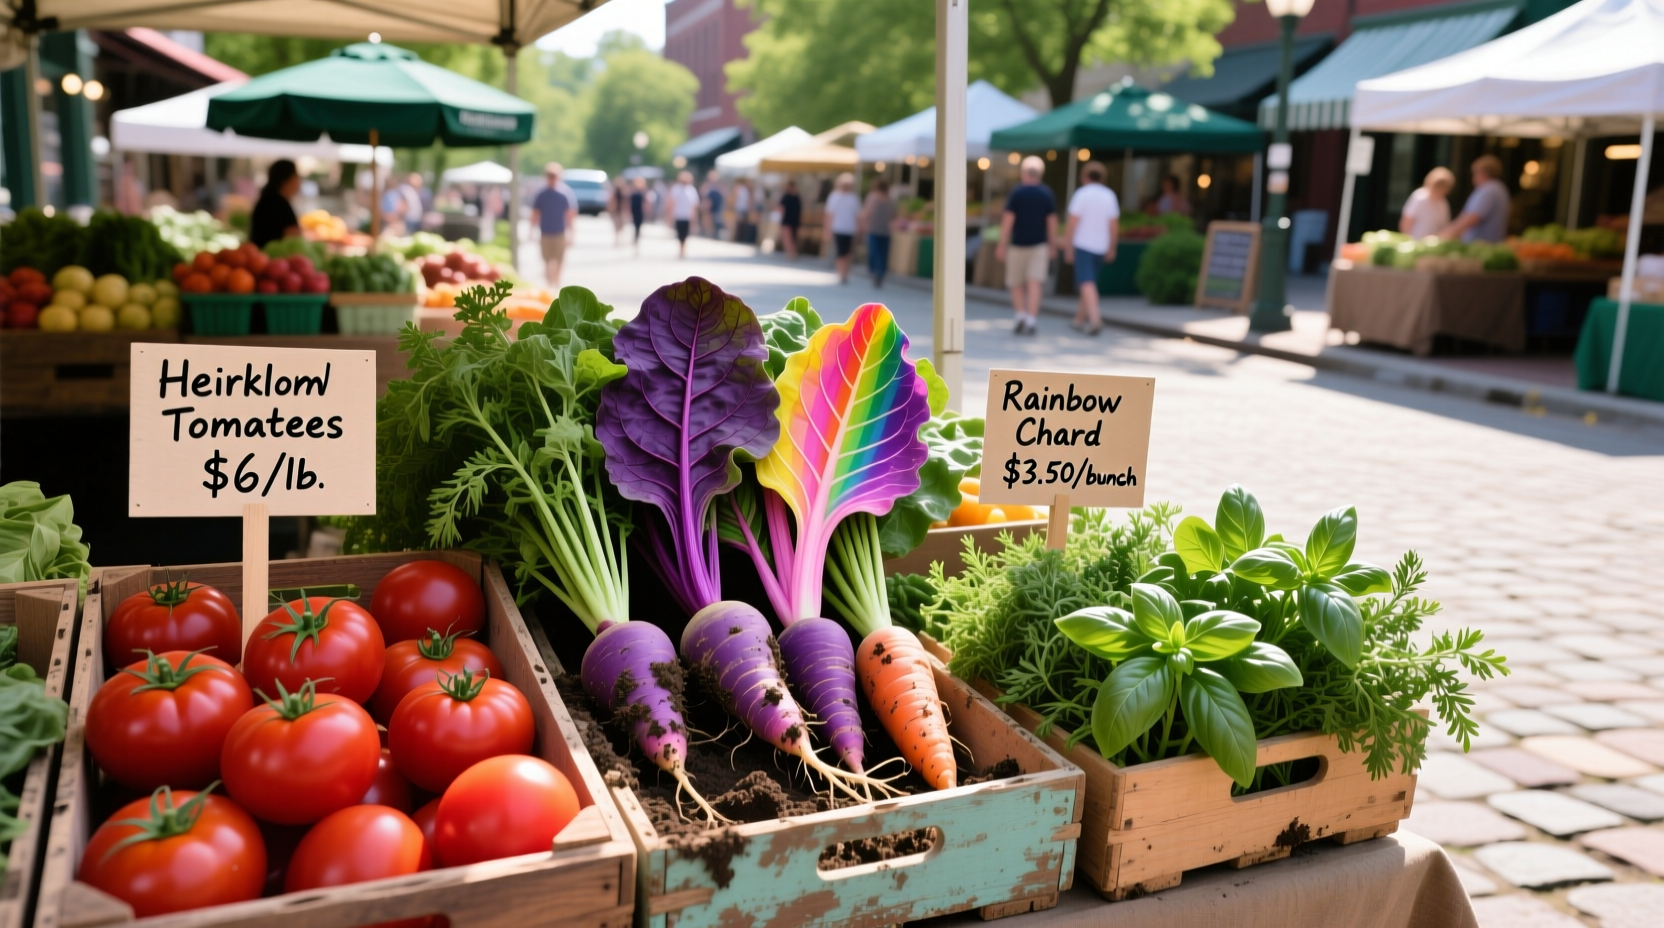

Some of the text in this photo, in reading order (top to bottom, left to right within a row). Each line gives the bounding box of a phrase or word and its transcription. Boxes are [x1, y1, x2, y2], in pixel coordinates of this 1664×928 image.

[1002, 379, 1123, 414] Rainbow
[161, 406, 344, 442] Tomatees
[1015, 416, 1103, 447] Chard
[202, 449, 325, 499] $6/lb.
[1002, 451, 1138, 490] $3.50/bunch
